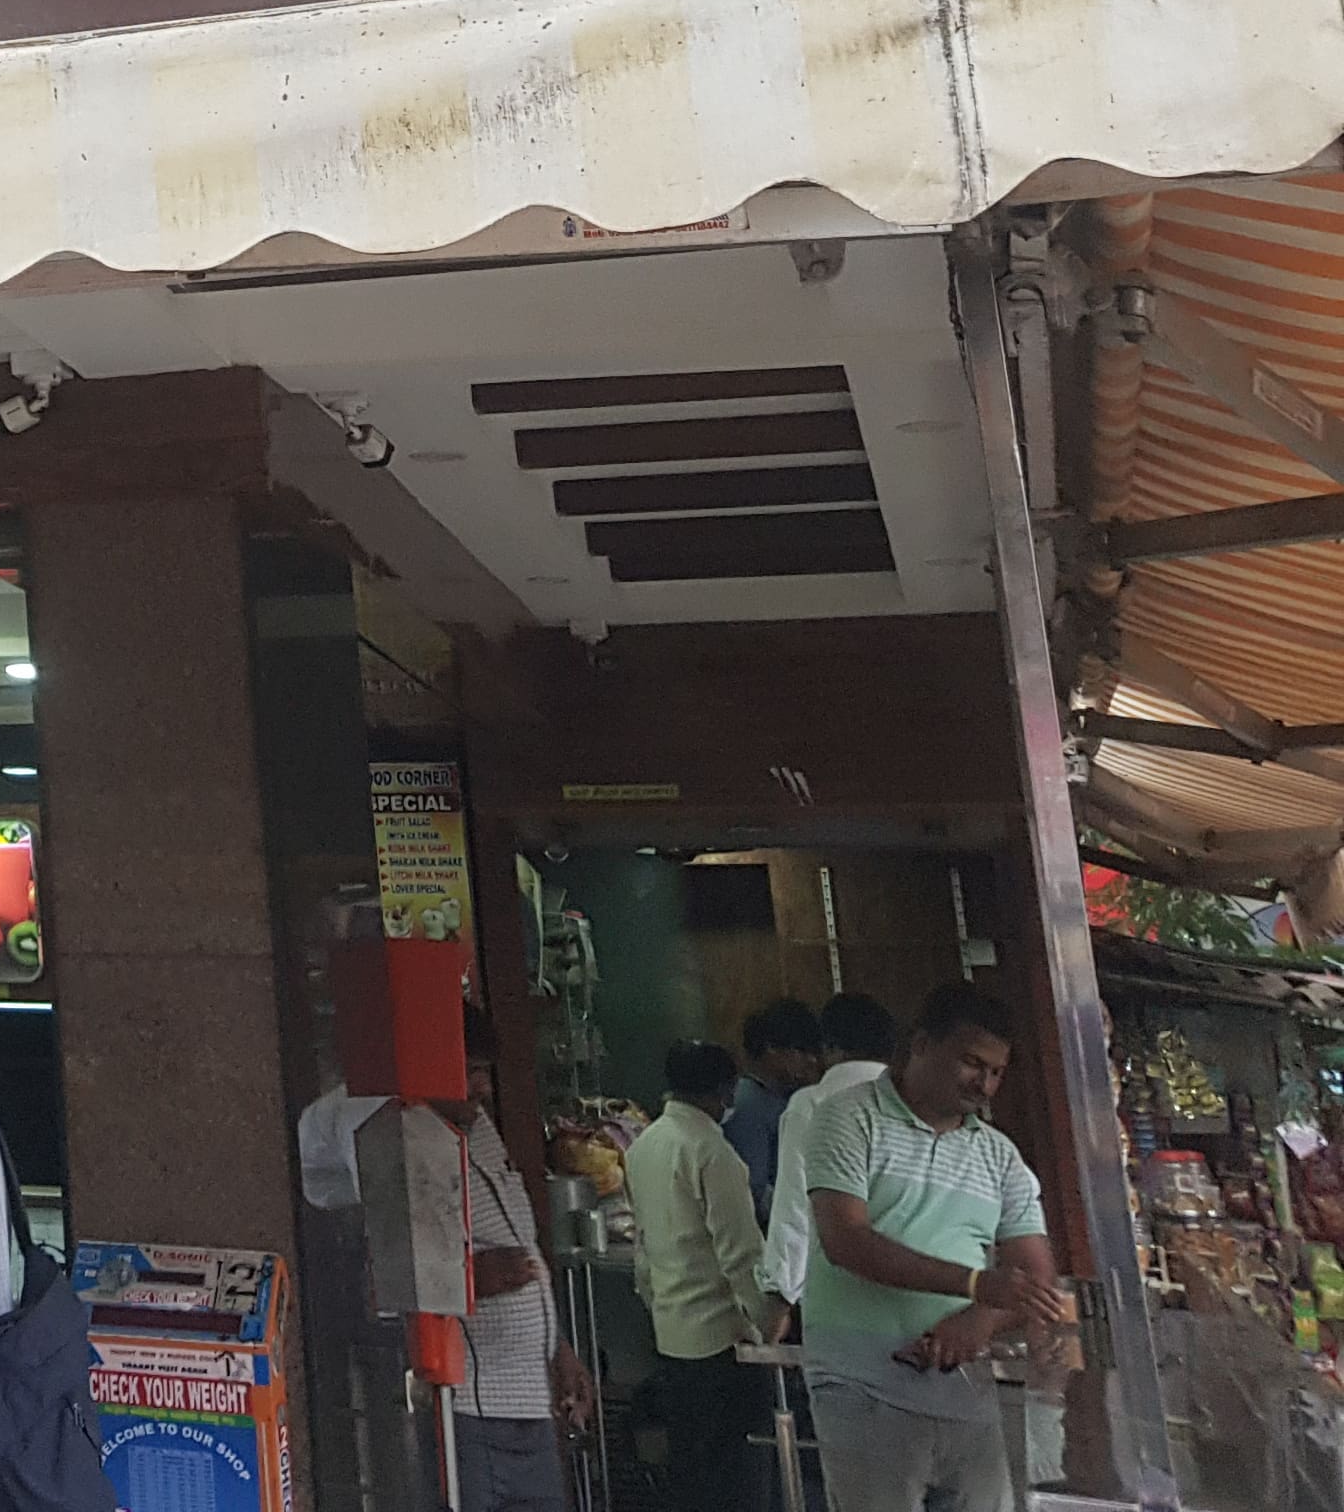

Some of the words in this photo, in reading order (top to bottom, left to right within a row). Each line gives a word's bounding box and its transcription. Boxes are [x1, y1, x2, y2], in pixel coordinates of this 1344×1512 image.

[371, 770, 392, 786] OD
[397, 770, 450, 786] CORNER
[89, 1372, 140, 1405] CHECK
[142, 1376, 187, 1409] YOUR
[187, 1380, 249, 1414] WEIGHT
[158, 1422, 177, 1436] TO
[181, 1426, 214, 1449] OUR
[215, 1442, 251, 1481] SHOP
